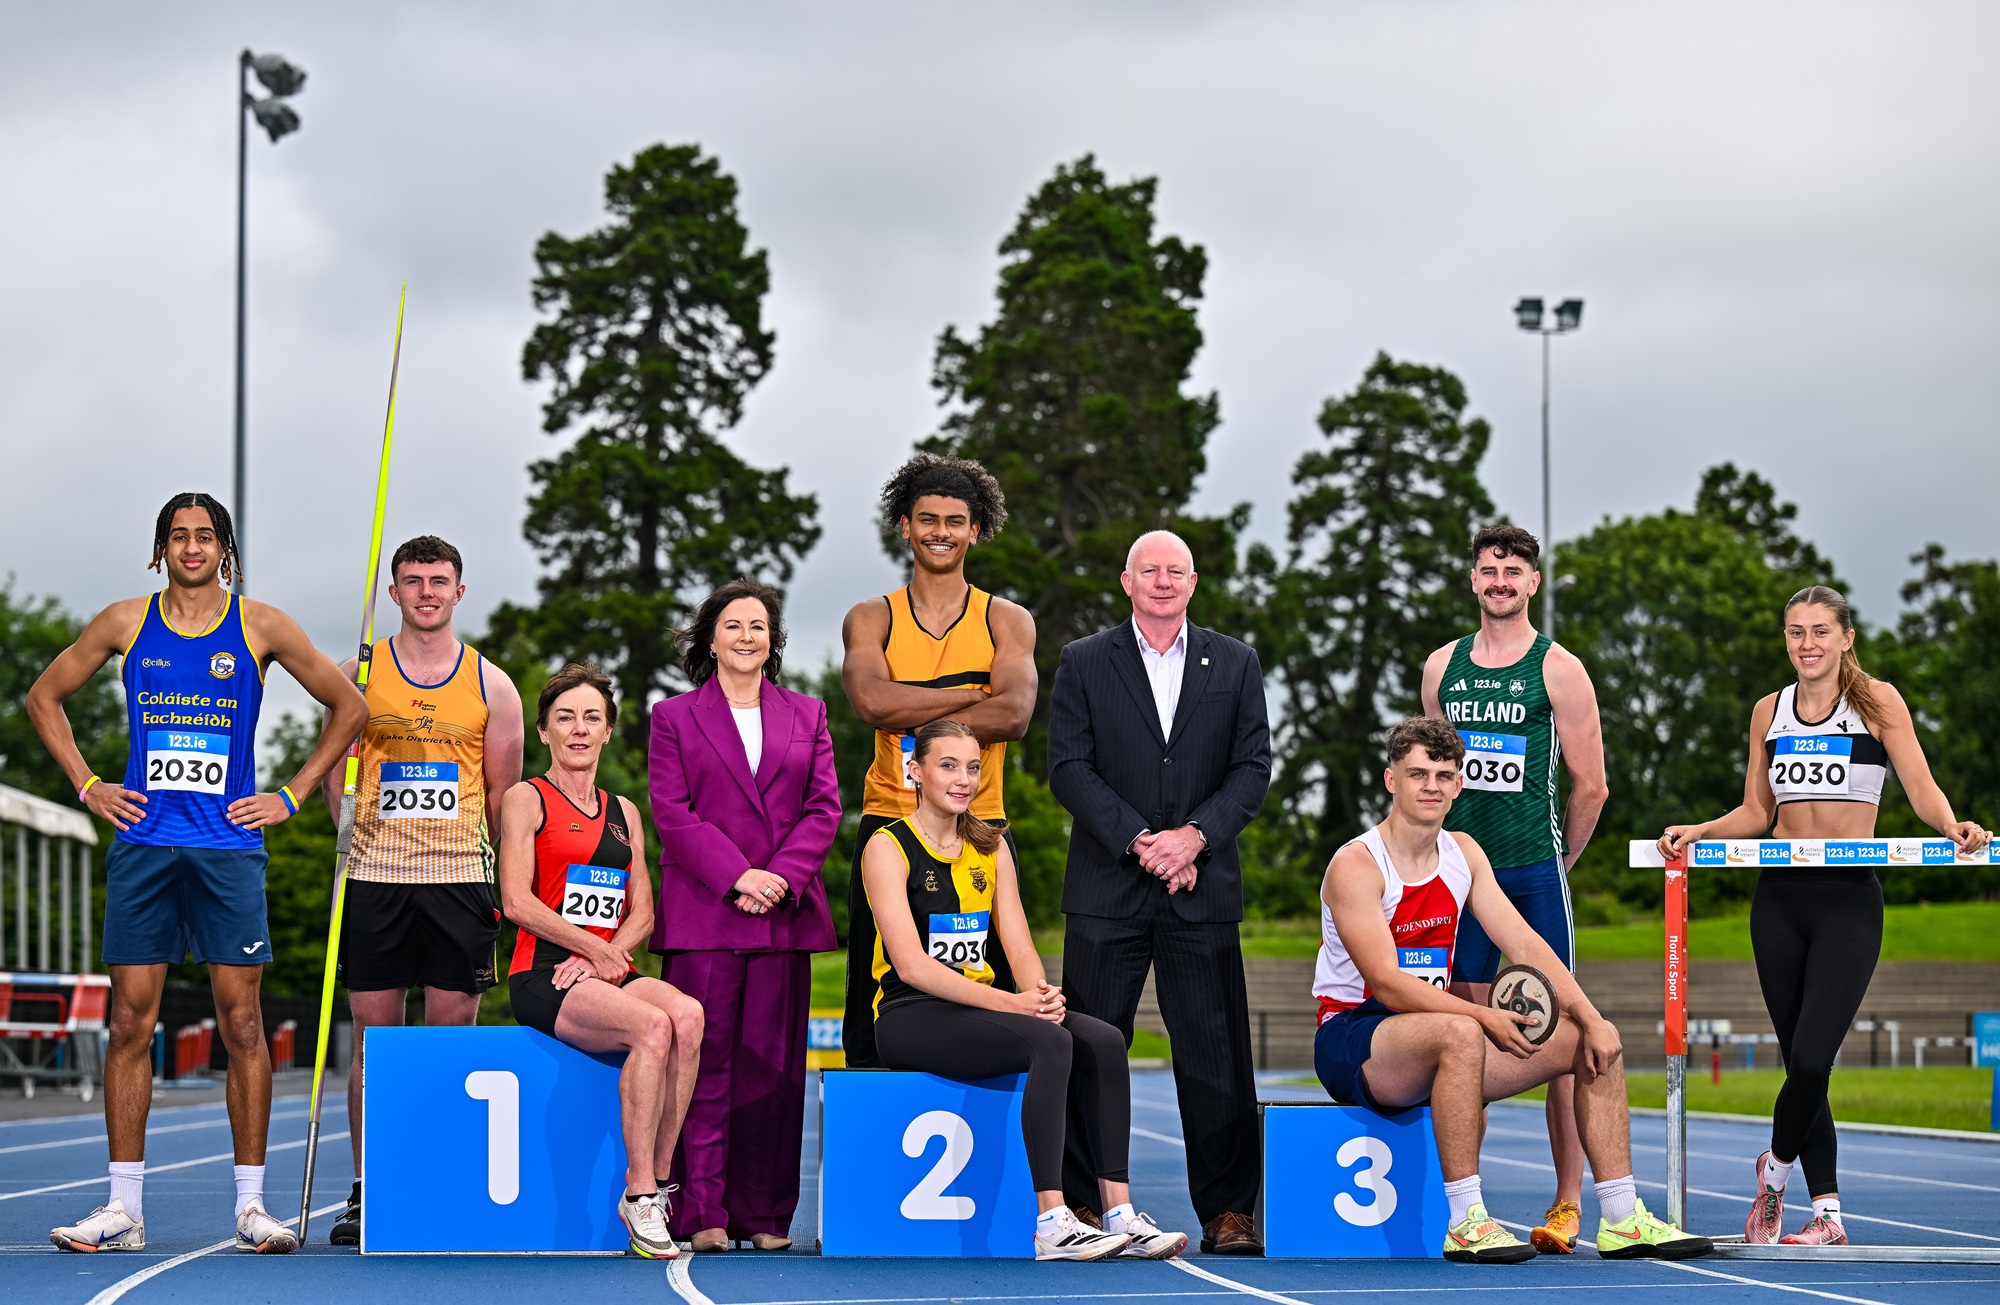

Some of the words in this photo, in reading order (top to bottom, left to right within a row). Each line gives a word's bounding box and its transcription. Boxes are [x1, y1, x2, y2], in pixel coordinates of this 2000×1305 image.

[1473, 679, 1502, 689] 123.ie
[216, 697, 238, 709] an
[1445, 700, 1526, 724] IRELAND
[168, 734, 207, 749] 123.ie
[380, 733, 404, 741] Lake
[405, 734, 443, 745] District
[1469, 734, 1504, 750] 123.ie
[1793, 739, 1829, 752] 123.ie
[149, 758, 224, 786] 2030
[400, 765, 438, 778] 123.ie
[1459, 758, 1521, 784] 030
[1774, 761, 1846, 786] 2030
[381, 788, 456, 812] 2030
[1696, 848, 1725, 859] 123.ie
[1760, 848, 1790, 859] 123.ie
[1826, 847, 1855, 858] 123.ie
[1857, 847, 1887, 858] 123.ie
[1923, 847, 1953, 858] 123.ie
[590, 869, 621, 886] 123.ie
[952, 917, 979, 932] 123.ie
[1405, 951, 1433, 965] 123.ie
[1669, 935, 1679, 970] nordic
[1667, 971, 1679, 1001] Sport
[464, 1070, 520, 1206] 1
[899, 1110, 977, 1221] 2
[1333, 1136, 1398, 1227] 3
